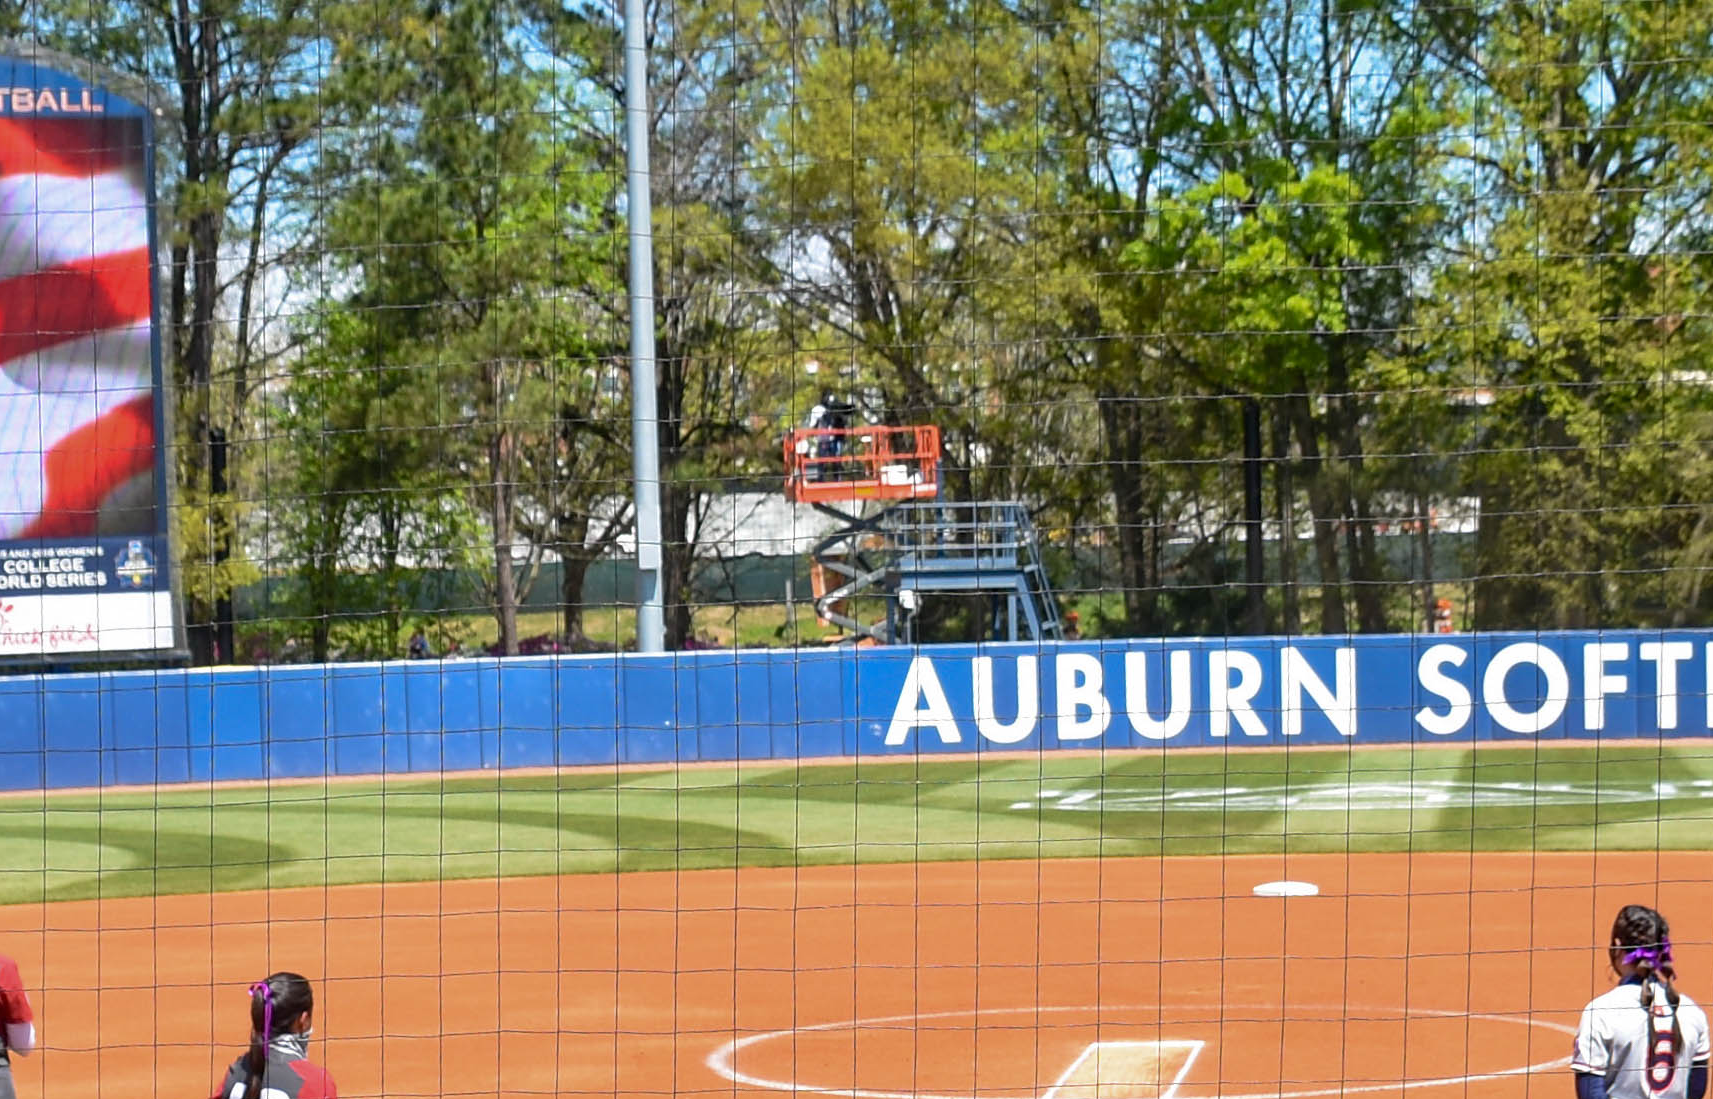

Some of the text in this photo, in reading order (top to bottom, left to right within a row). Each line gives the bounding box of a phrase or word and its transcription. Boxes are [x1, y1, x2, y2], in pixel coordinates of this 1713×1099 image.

[3, 557, 86, 574] COLLEGE
[46, 571, 108, 588] SERIES
[884, 646, 1356, 746] AUBURN
